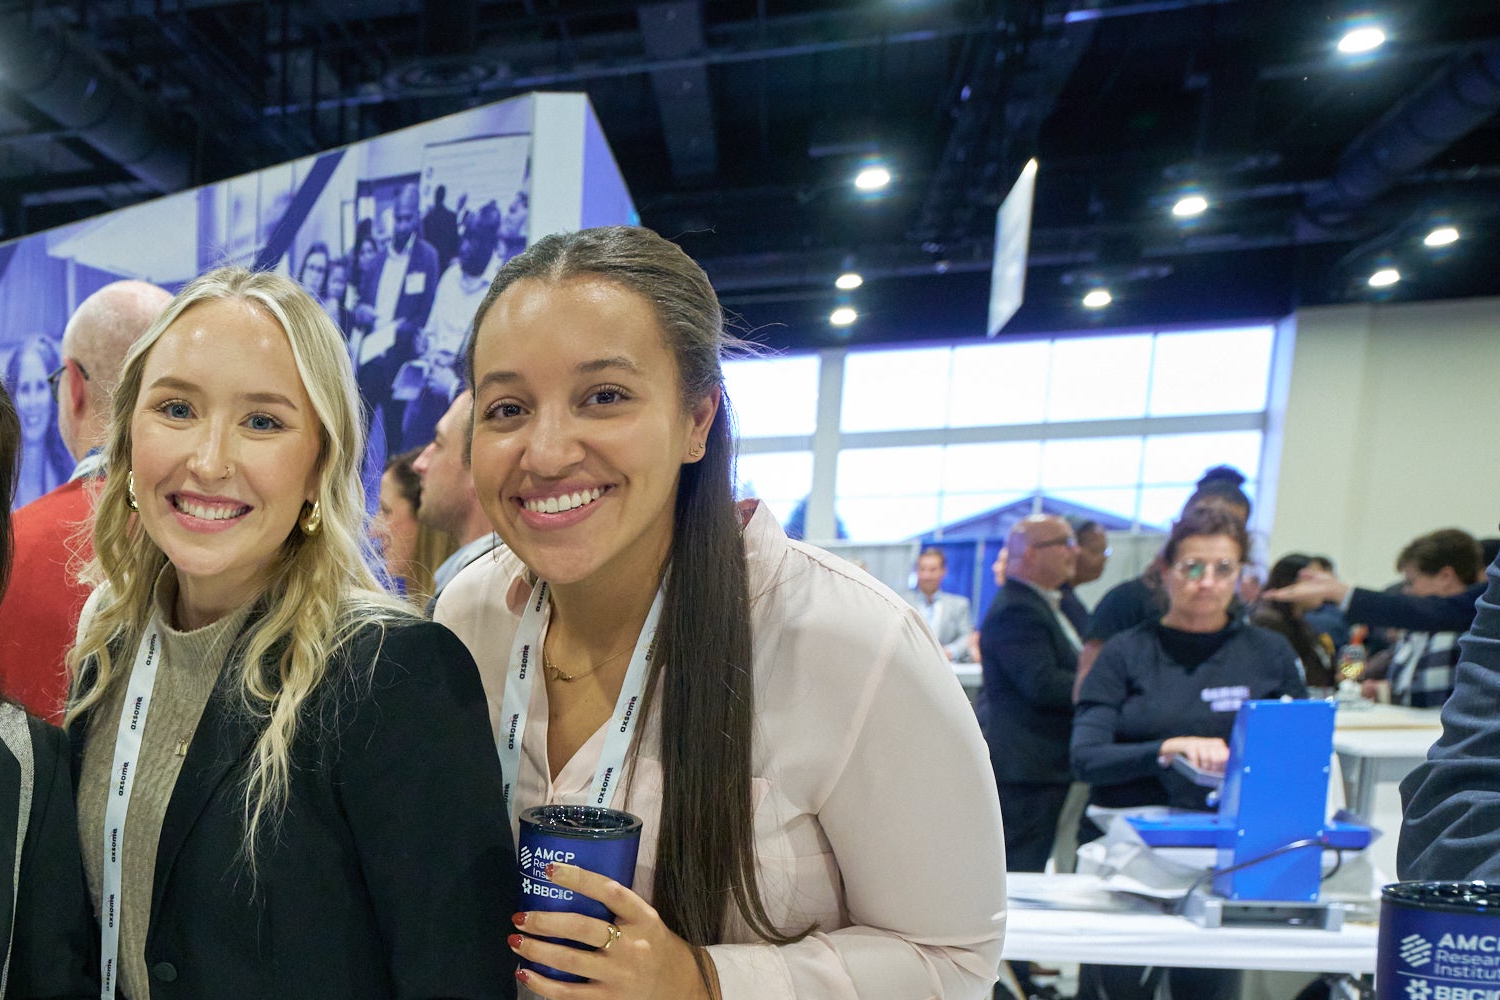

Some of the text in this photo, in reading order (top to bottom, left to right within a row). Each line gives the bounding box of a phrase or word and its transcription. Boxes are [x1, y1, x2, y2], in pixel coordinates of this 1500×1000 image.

[536, 581, 547, 612] axsom
[146, 633, 157, 666] axsome
[519, 644, 530, 680] axsome
[131, 696, 143, 730] axsome
[620, 696, 638, 733] axsome
[508, 713, 519, 750] axsome
[118, 761, 129, 796] axsome
[597, 767, 614, 804] axsome
[534, 847, 575, 863] AMCP
[533, 884, 574, 901] BBCIC
[1435, 949, 1500, 965] Resear
